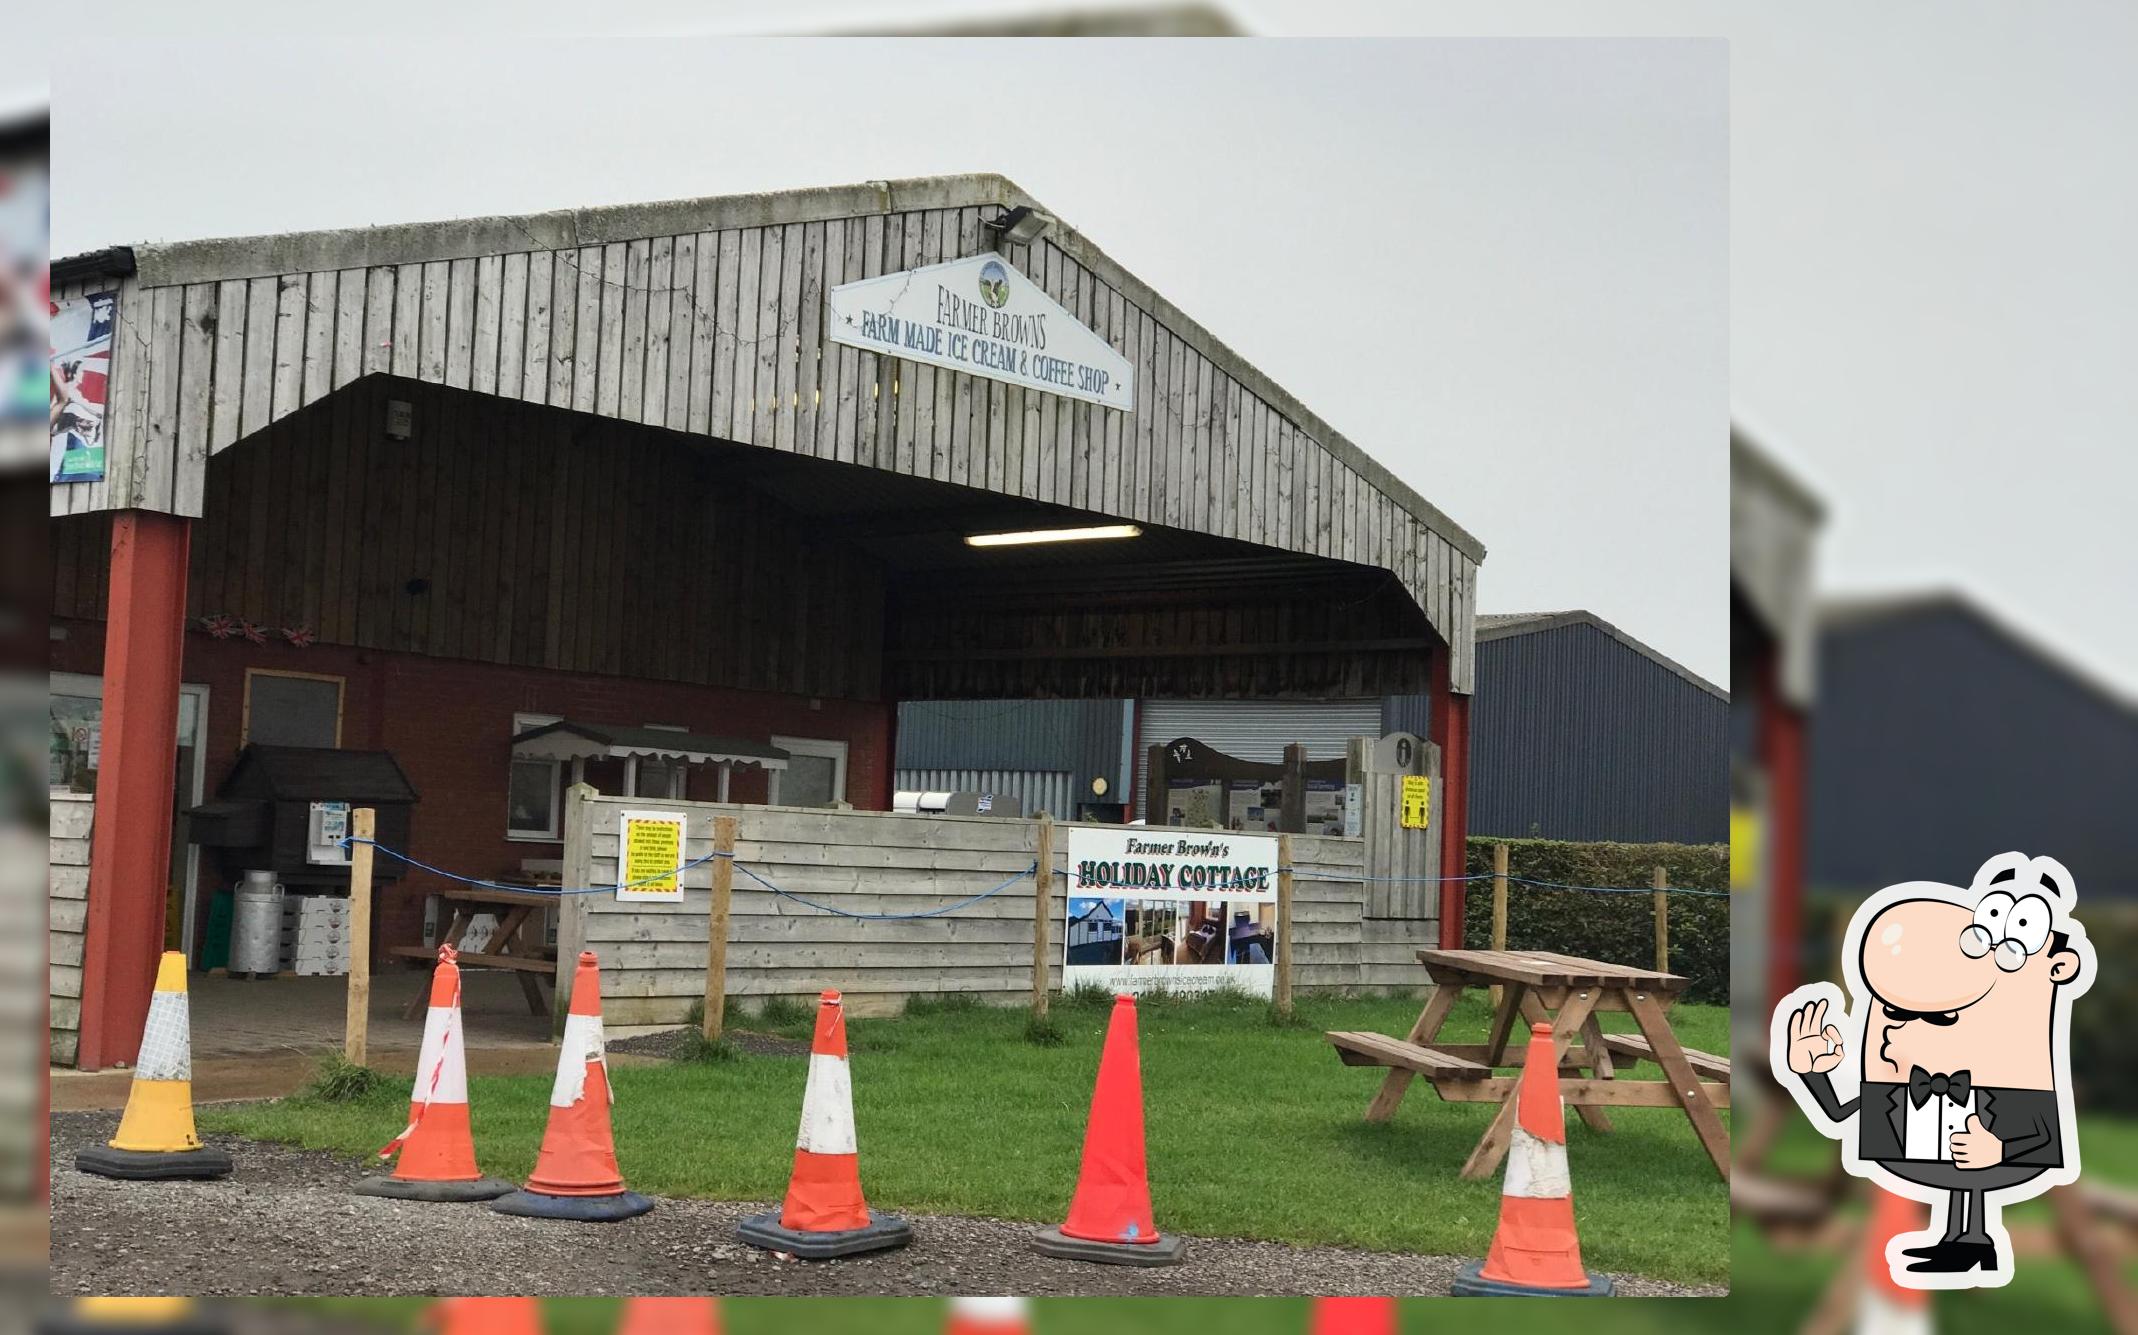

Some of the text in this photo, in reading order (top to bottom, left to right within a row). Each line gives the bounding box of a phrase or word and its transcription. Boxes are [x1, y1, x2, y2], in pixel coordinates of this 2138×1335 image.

[936, 284, 1046, 350] FARMER BROWNS
[862, 310, 1109, 395] FARM MADE ICE CREAM & COFFEE SHOP
[1125, 838, 1230, 858] Farmer Brown's
[1077, 861, 1270, 893] HOLIDAY COTTAGE
